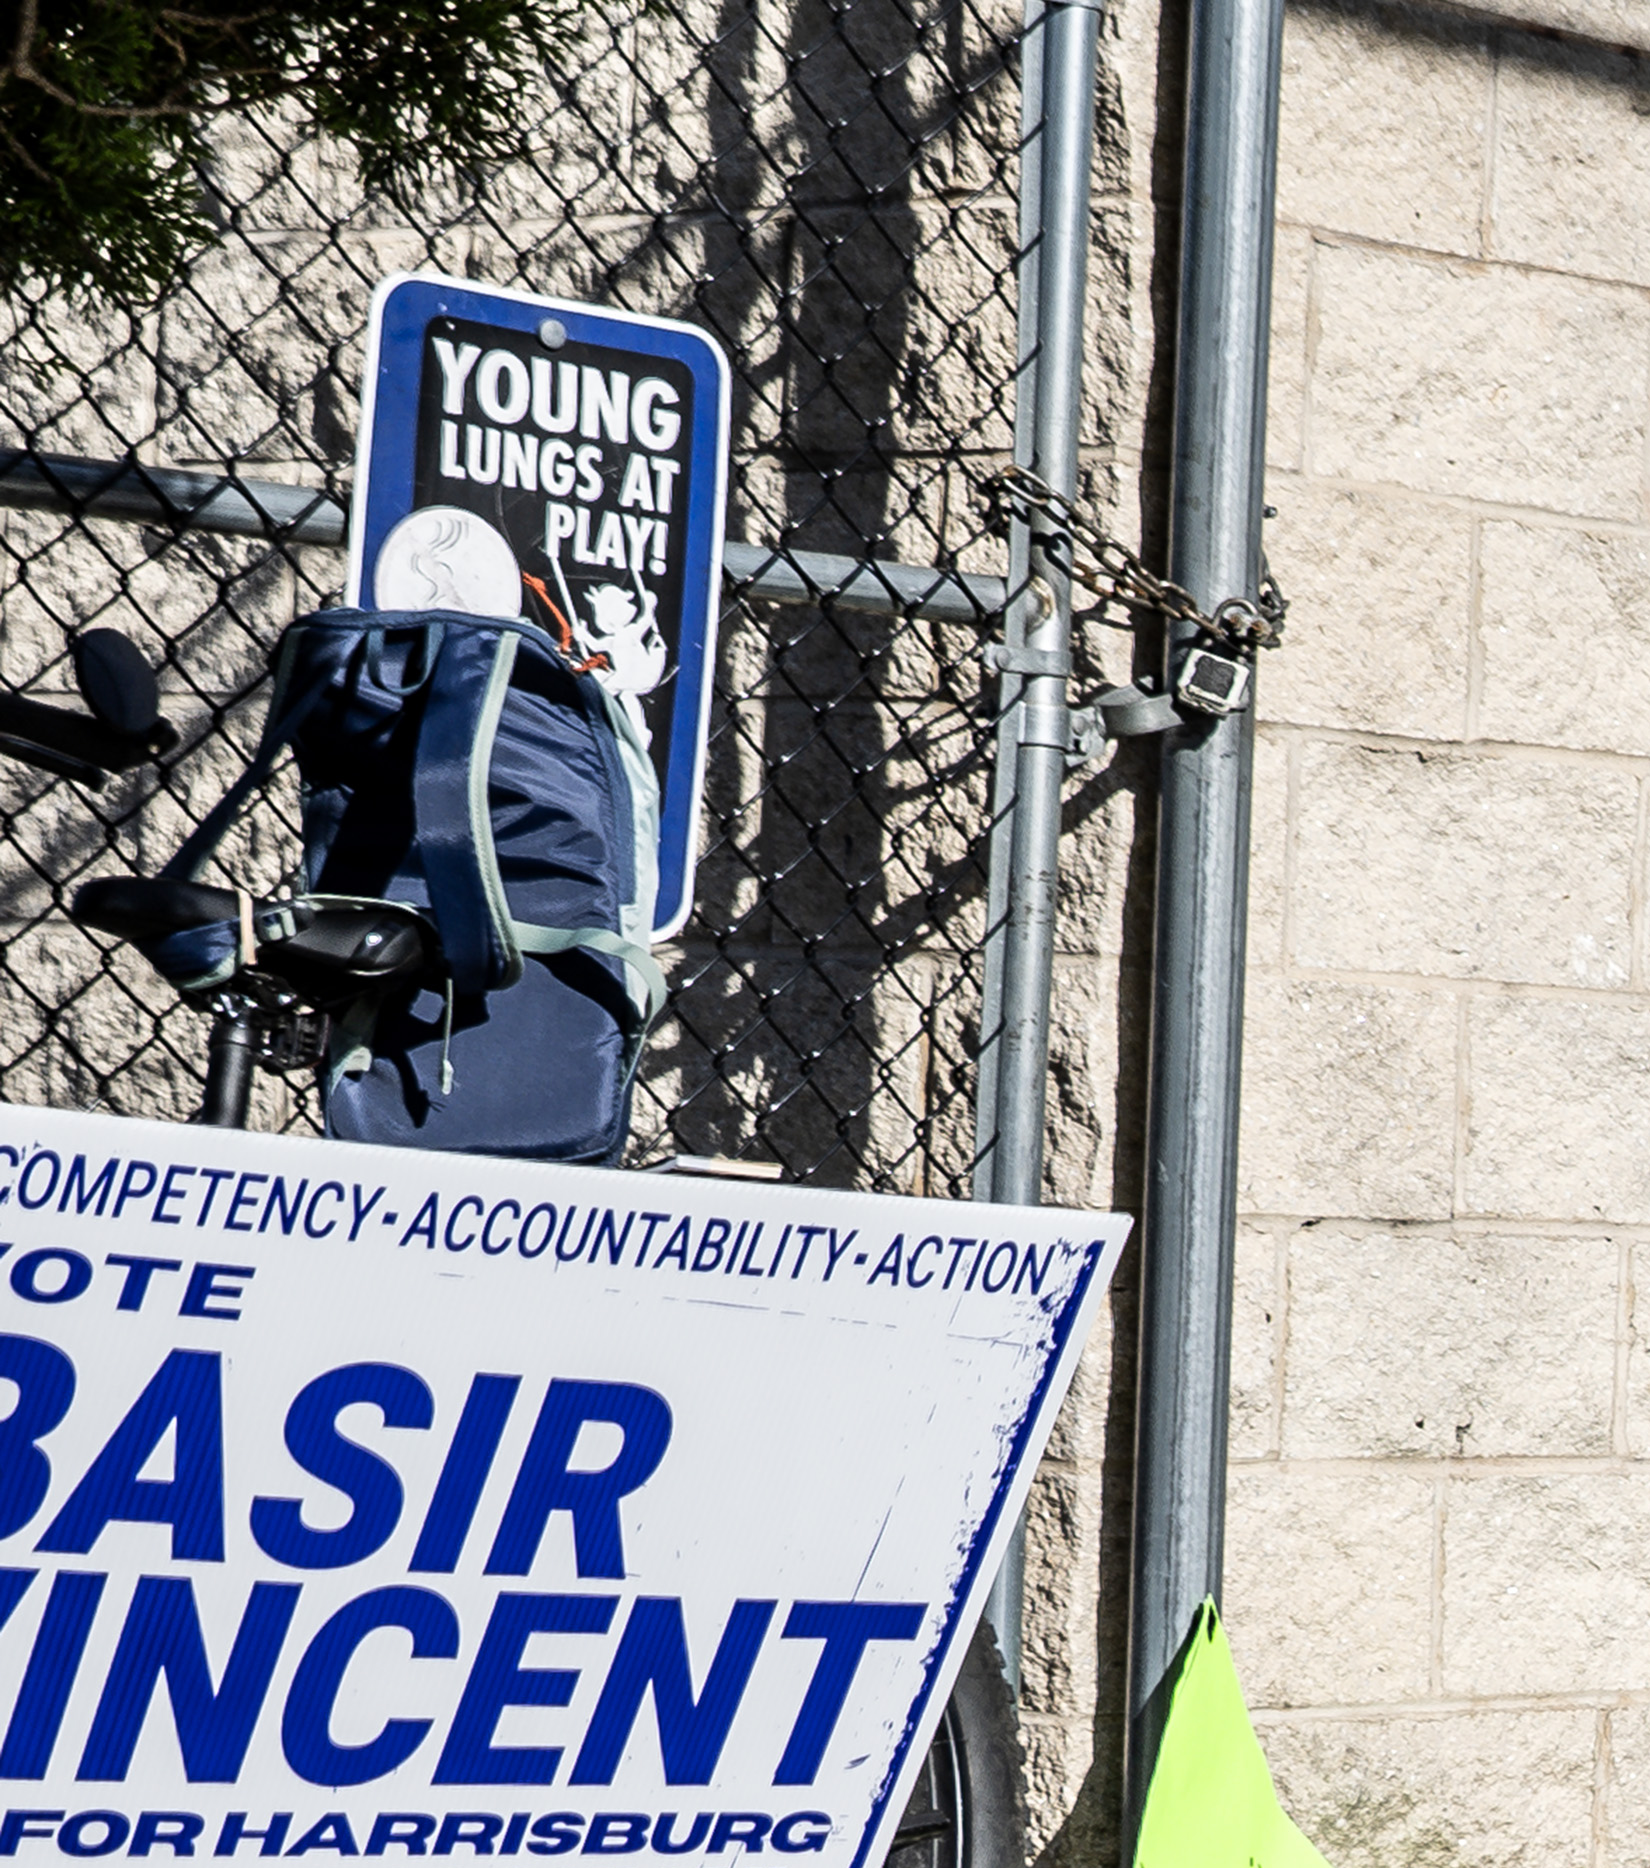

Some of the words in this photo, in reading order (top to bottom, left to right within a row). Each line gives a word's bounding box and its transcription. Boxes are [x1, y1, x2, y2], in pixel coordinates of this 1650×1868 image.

[432, 336, 681, 452] YOUNG
[440, 419, 603, 502] LUNGS
[618, 453, 681, 514] AT
[546, 502, 669, 576] PLAY!
[0, 1242, 256, 1320] OTE
[400, 1192, 852, 1285] ACCOUNTABILITY
[873, 1239, 1053, 1297] ACTION
[0, 1567, 929, 1789] INCENT
[0, 1808, 204, 1857] FOR
[215, 1809, 832, 1858] HARRISBURG
